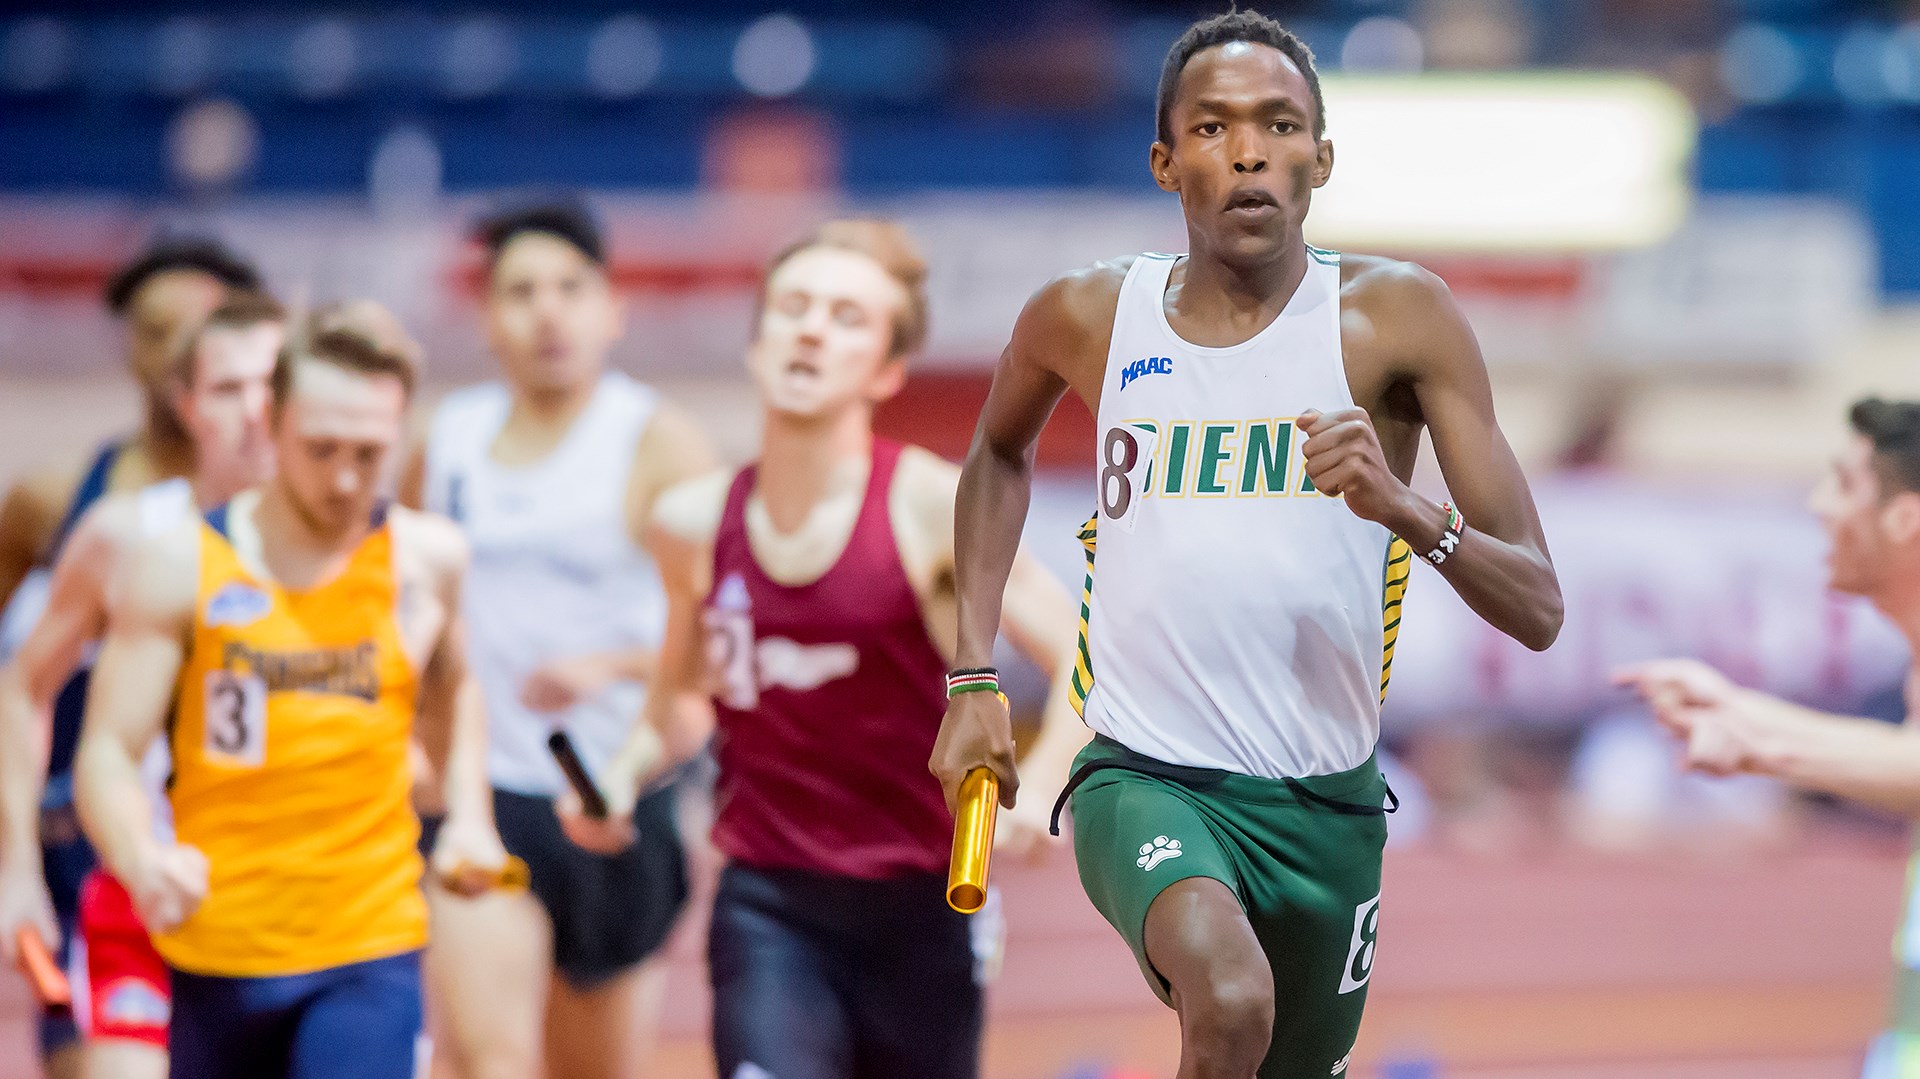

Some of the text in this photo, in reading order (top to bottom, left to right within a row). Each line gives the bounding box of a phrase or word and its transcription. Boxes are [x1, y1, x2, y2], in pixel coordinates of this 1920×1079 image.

[1120, 357, 1173, 392] MAAC
[1102, 427, 1139, 521] 8
[1120, 417, 1344, 499] IEN
[212, 676, 249, 755] 3
